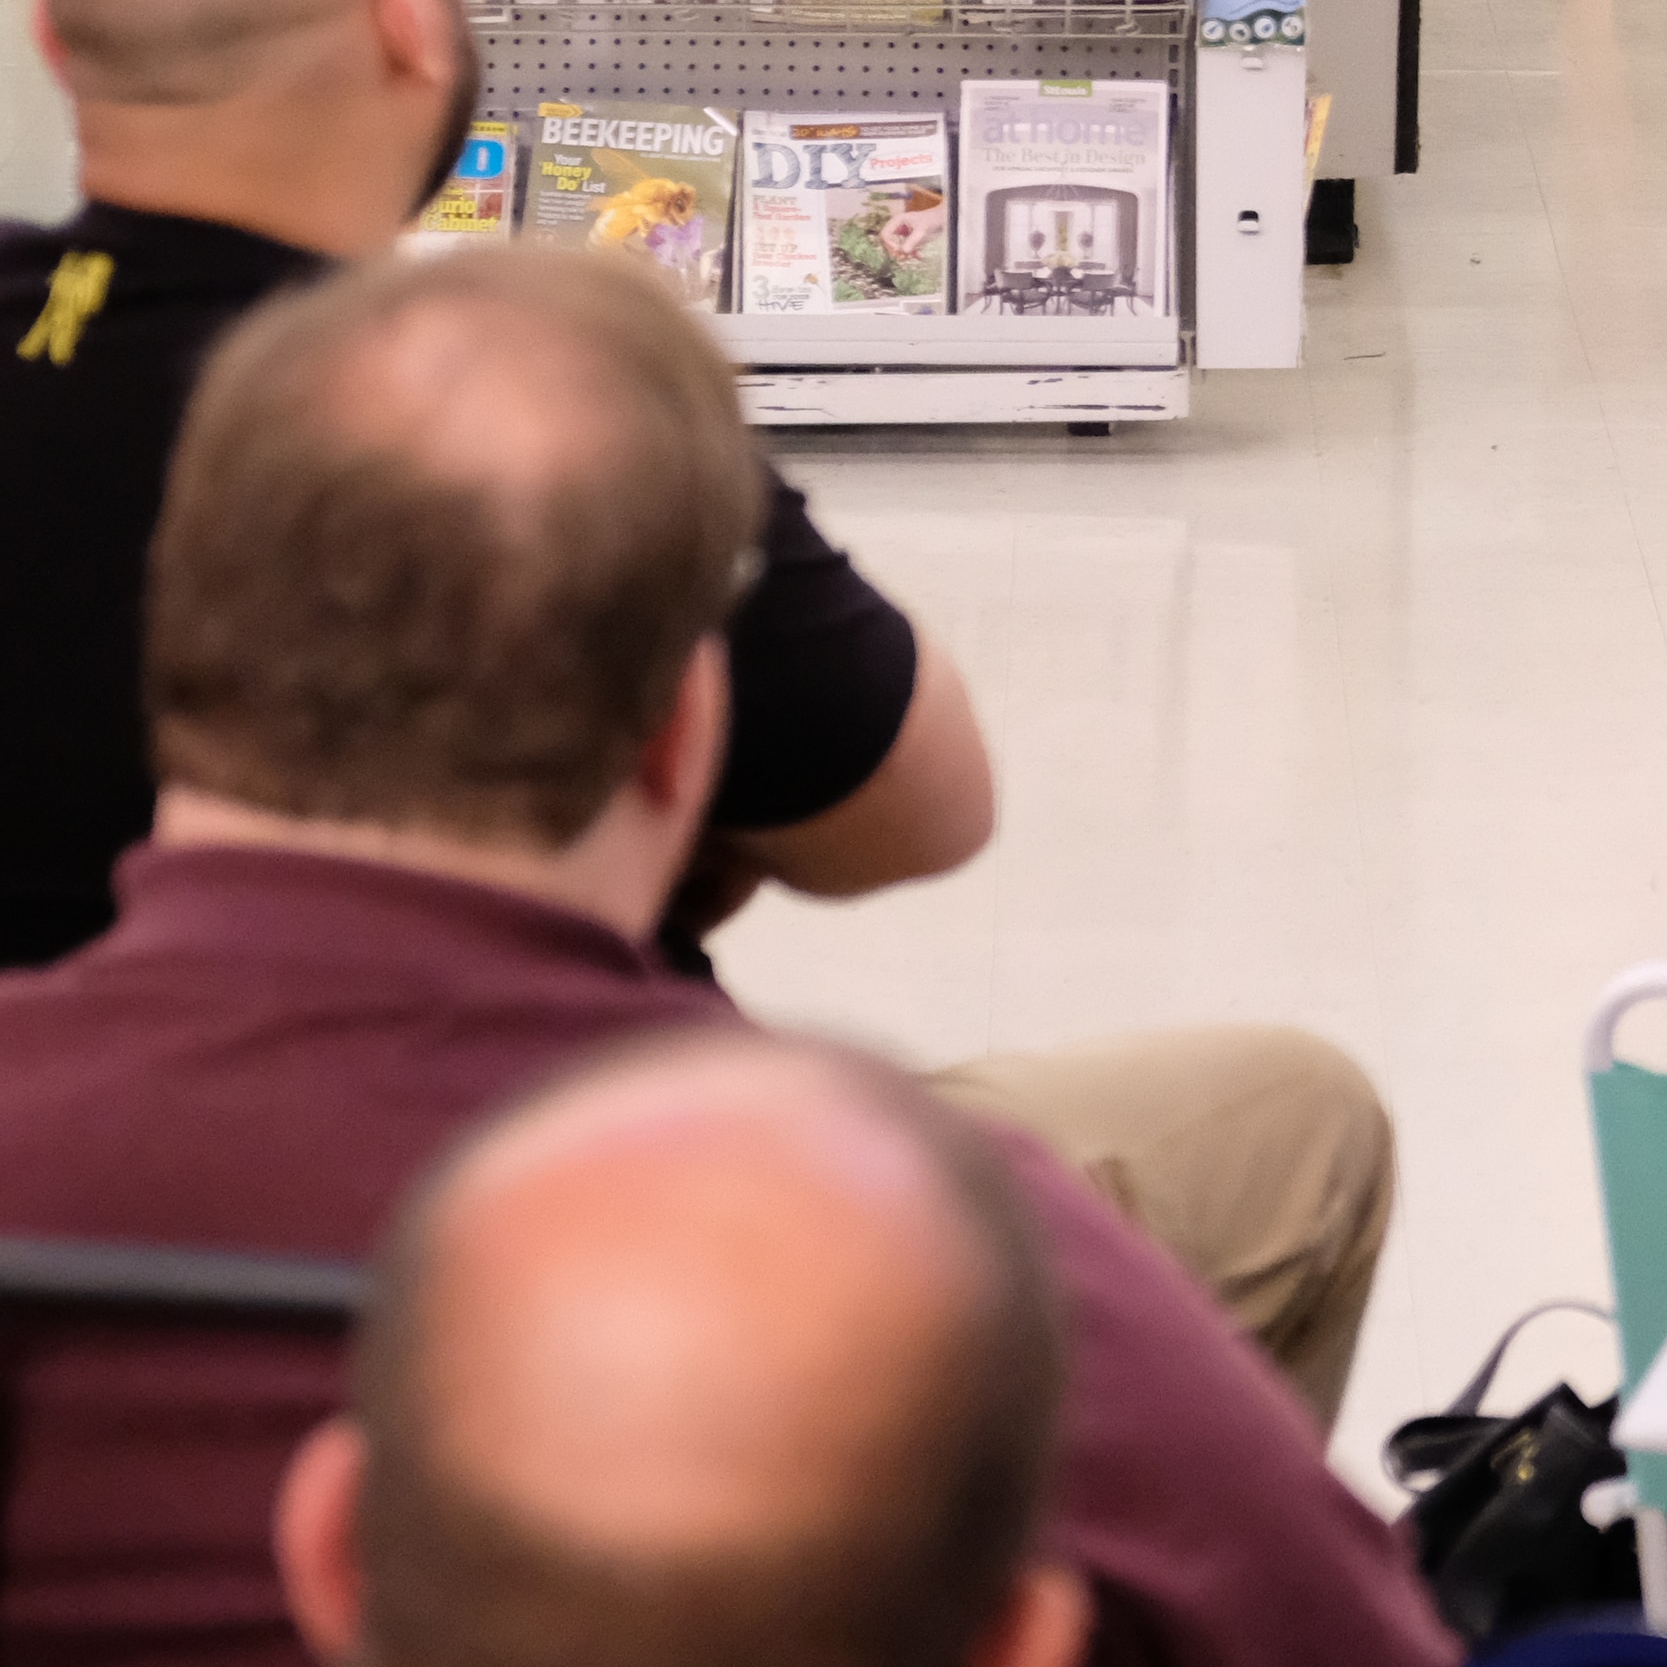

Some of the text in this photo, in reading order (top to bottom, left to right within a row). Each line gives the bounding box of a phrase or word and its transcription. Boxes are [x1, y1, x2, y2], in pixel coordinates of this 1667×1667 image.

[541, 116, 725, 156] BEEKEEPING
[553, 153, 583, 166] Your
[752, 141, 877, 190] DIY
[869, 153, 934, 170] Projects
[984, 148, 1016, 163] The
[1021, 148, 1058, 165] Best
[1085, 149, 1147, 166] Design
[582, 180, 606, 194] List
[752, 275, 770, 298] 3
[758, 299, 805, 312] HIVE
